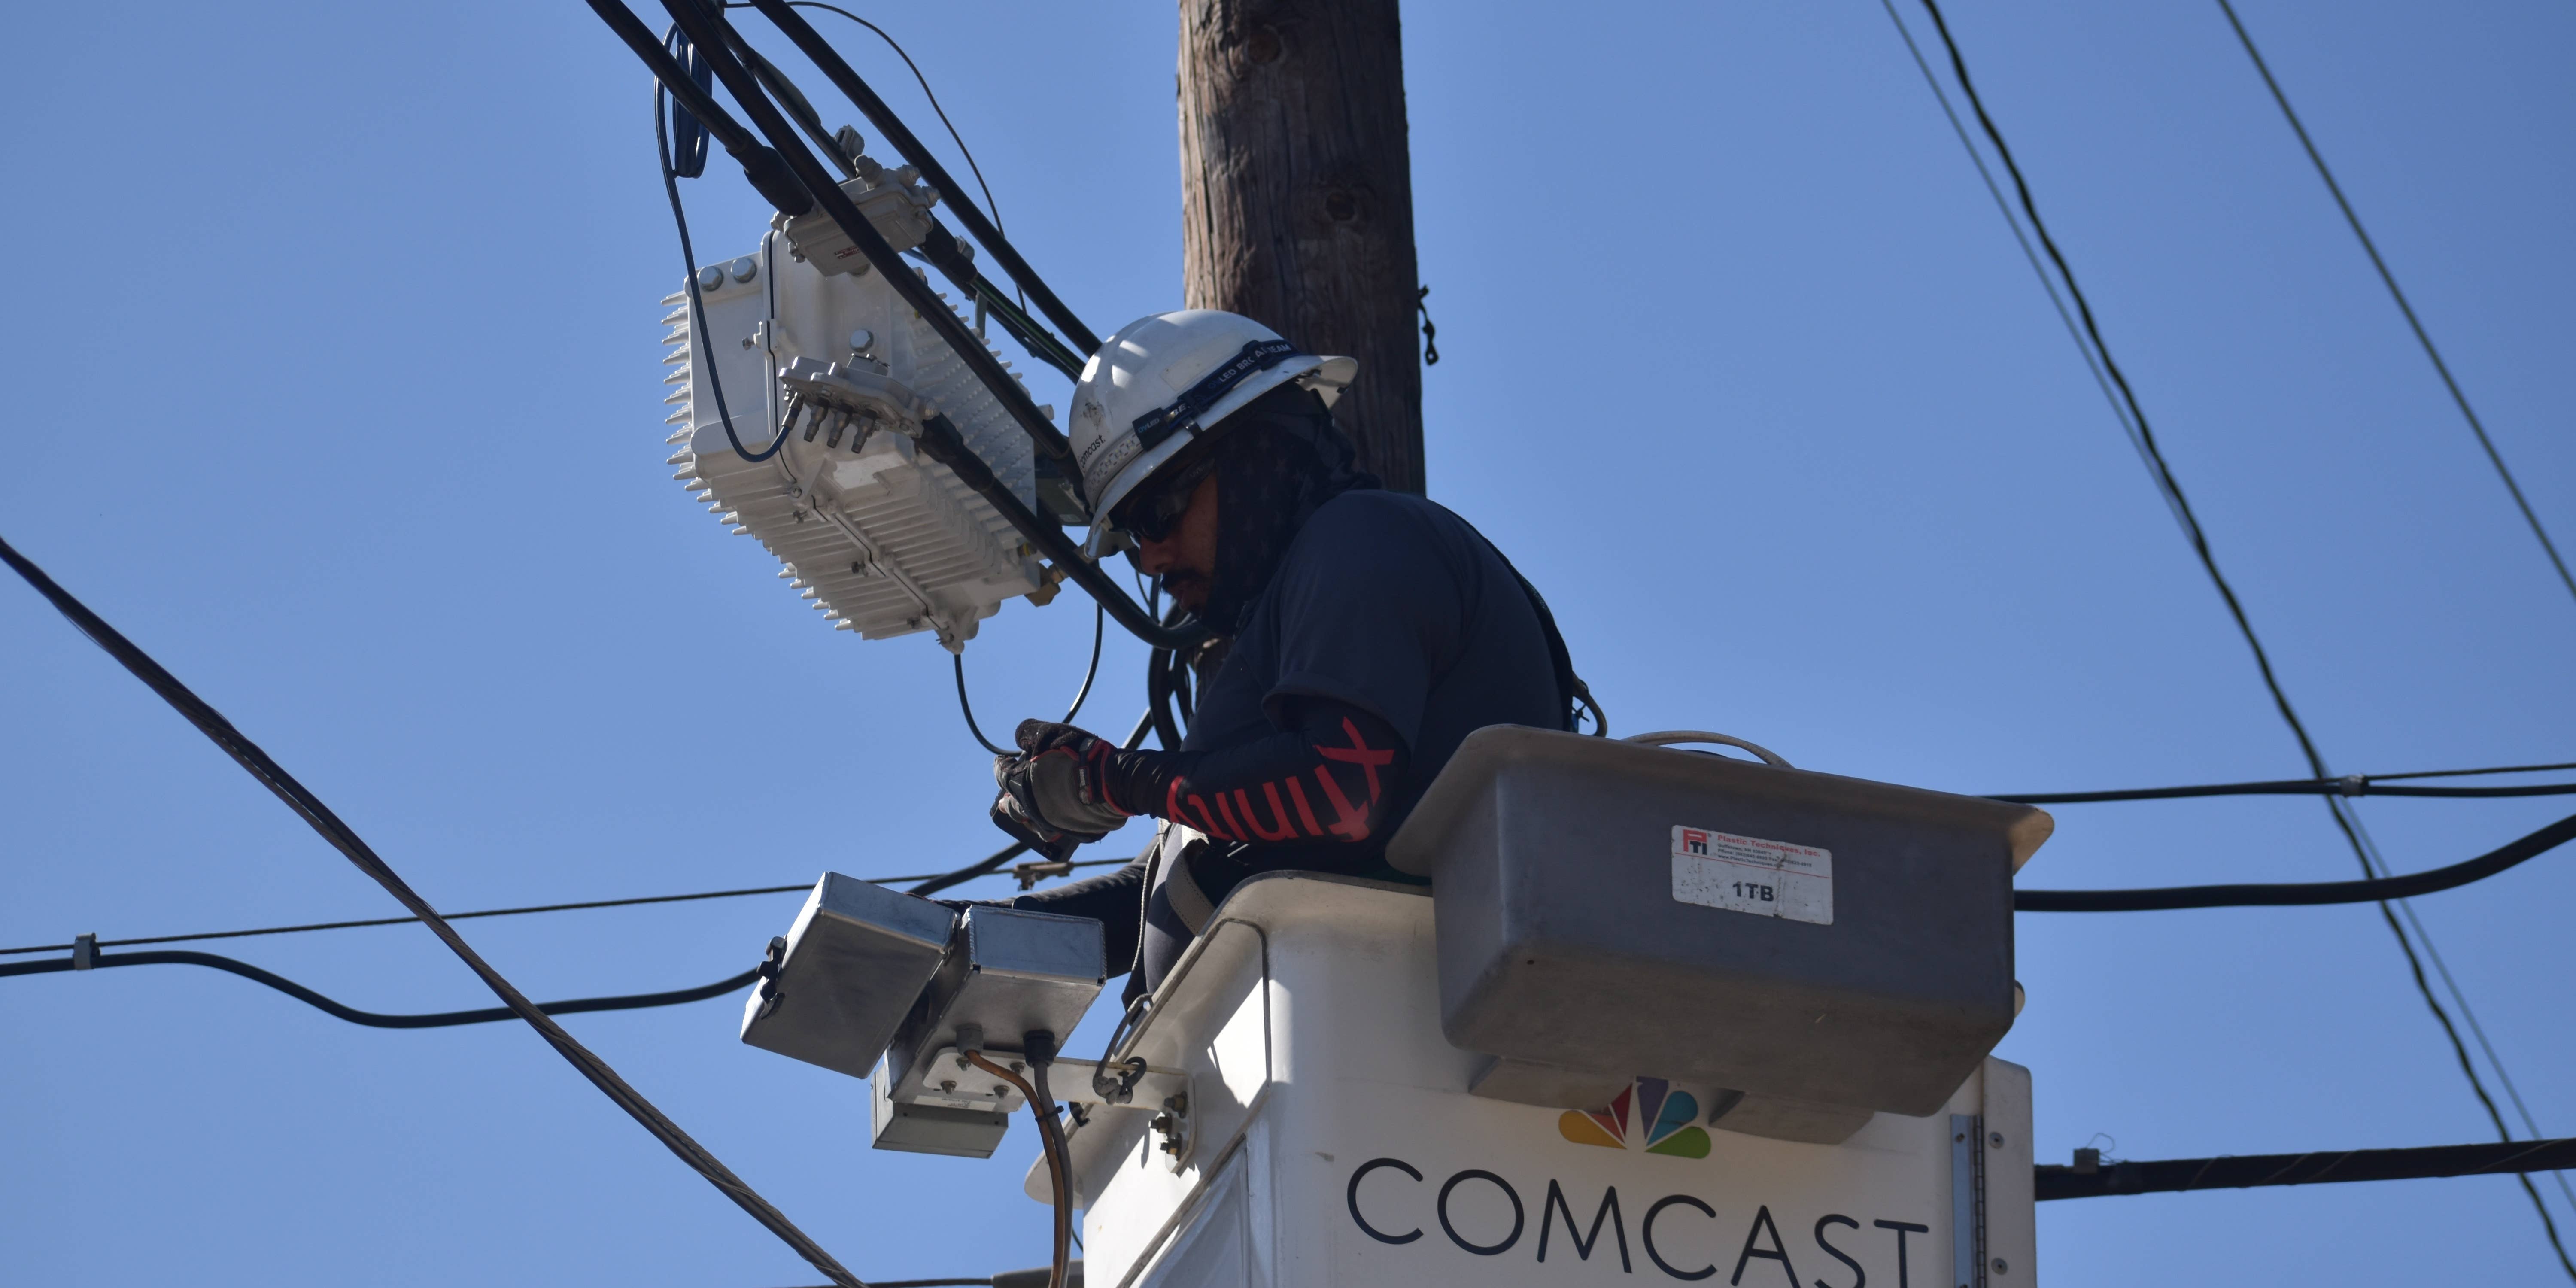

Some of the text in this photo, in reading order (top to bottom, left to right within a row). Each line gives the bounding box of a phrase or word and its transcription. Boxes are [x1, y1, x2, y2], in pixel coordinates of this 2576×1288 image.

[1683, 829, 1707, 855] PTI
[1717, 835, 1821, 857] Plastic Techniques, Inc.
[1733, 881, 1774, 902] 1TB
[1347, 1157, 1929, 1288] COMCAST
